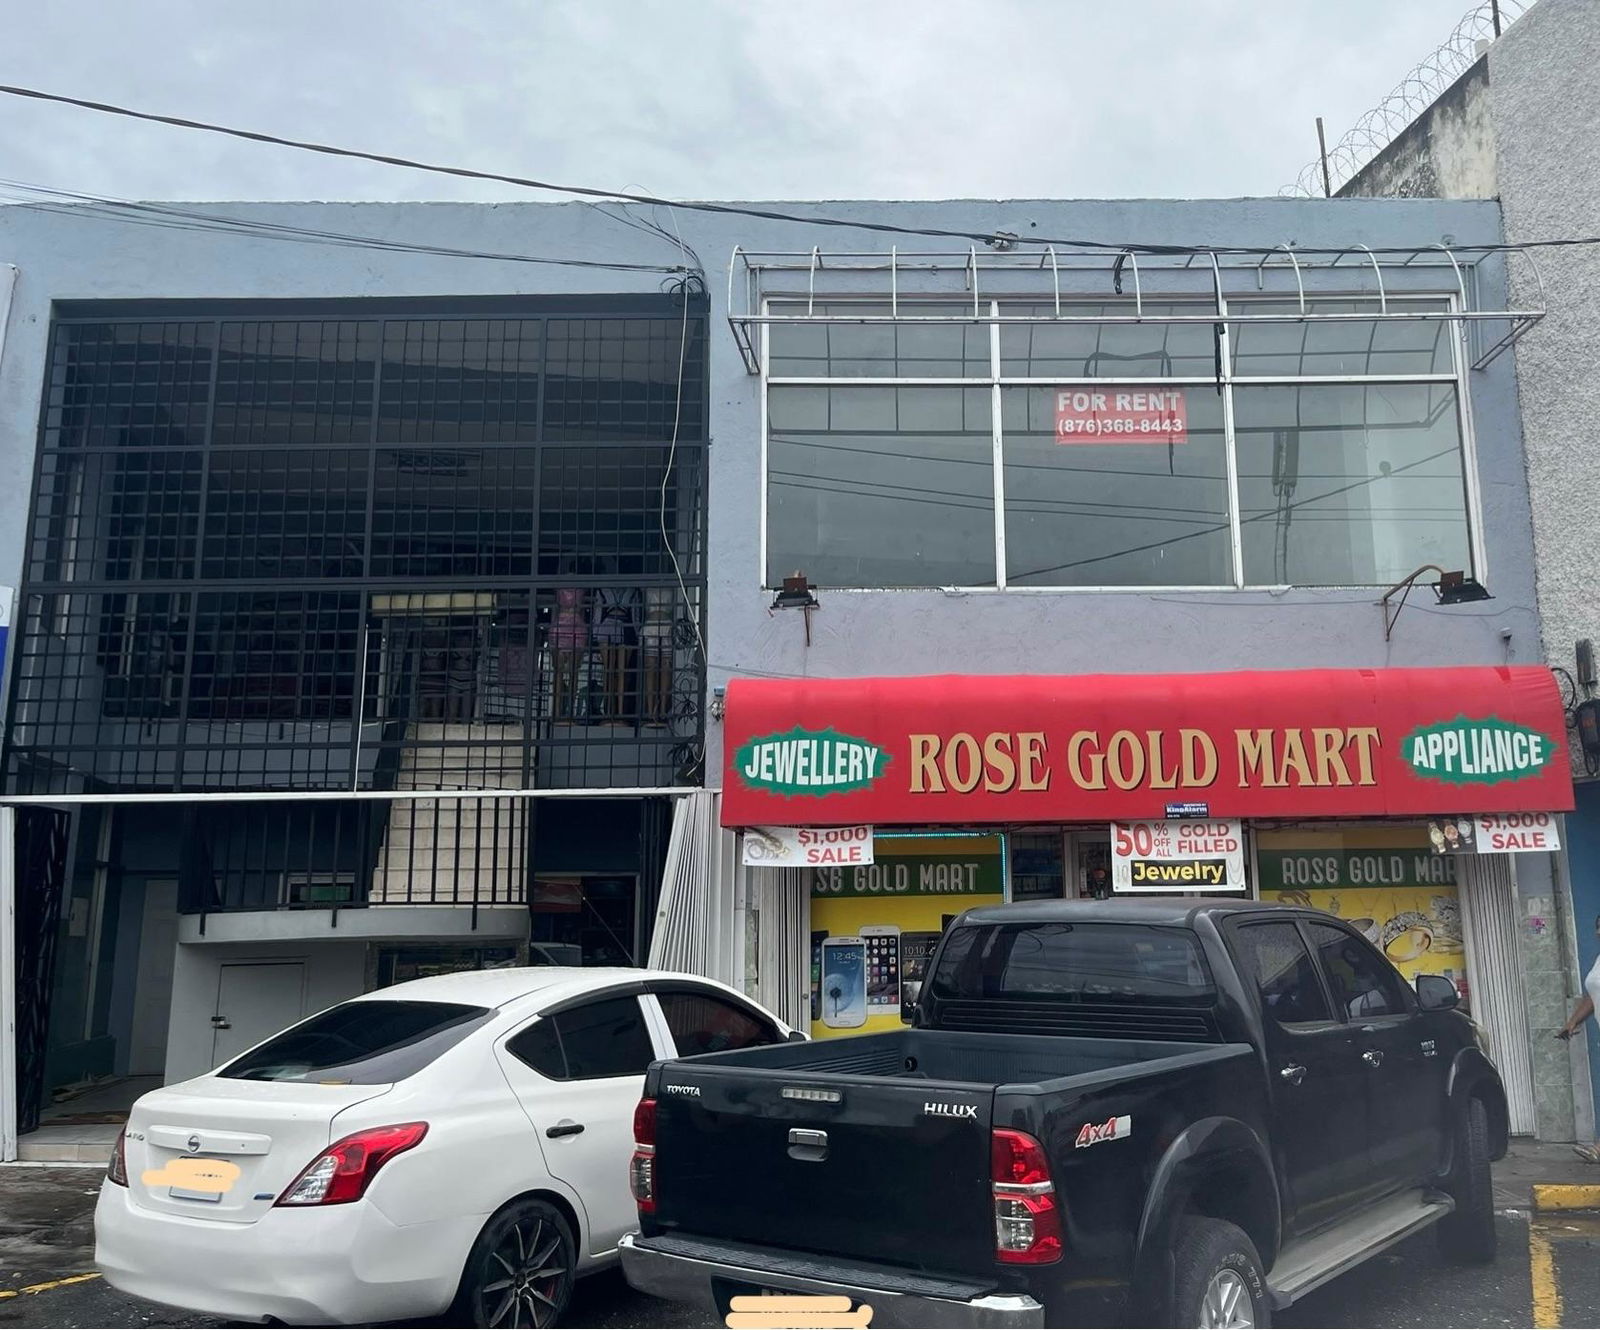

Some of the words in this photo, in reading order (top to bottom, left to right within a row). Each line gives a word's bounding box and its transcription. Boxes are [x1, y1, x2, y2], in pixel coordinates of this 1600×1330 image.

[1058, 392, 1107, 412] FOR
[1116, 392, 1181, 412] RENT
[1058, 419, 1183, 436] (876)368-8443
[909, 731, 1052, 794] ROSE
[1067, 728, 1219, 791] GOLD
[1235, 726, 1381, 789] MART
[1412, 727, 1544, 775] APPLIANCE
[745, 739, 878, 786] JEWELLERY
[1180, 824, 1229, 838] GOLD
[1481, 812, 1550, 832] $1,000
[798, 826, 868, 847] $1,000
[1154, 838, 1171, 848] OFF
[1177, 839, 1238, 853] FILLED
[1492, 831, 1547, 849] SALE
[807, 846, 862, 863] SALE
[1156, 848, 1173, 857] ALL
[853, 864, 909, 892] GOLD
[919, 863, 979, 892] MART
[1133, 861, 1224, 884] Jewelry
[1349, 856, 1404, 884] GOLD
[1414, 855, 1457, 882] MAR
[667, 1084, 701, 1097] TOYOTA
[924, 1102, 978, 1119] HILUX
